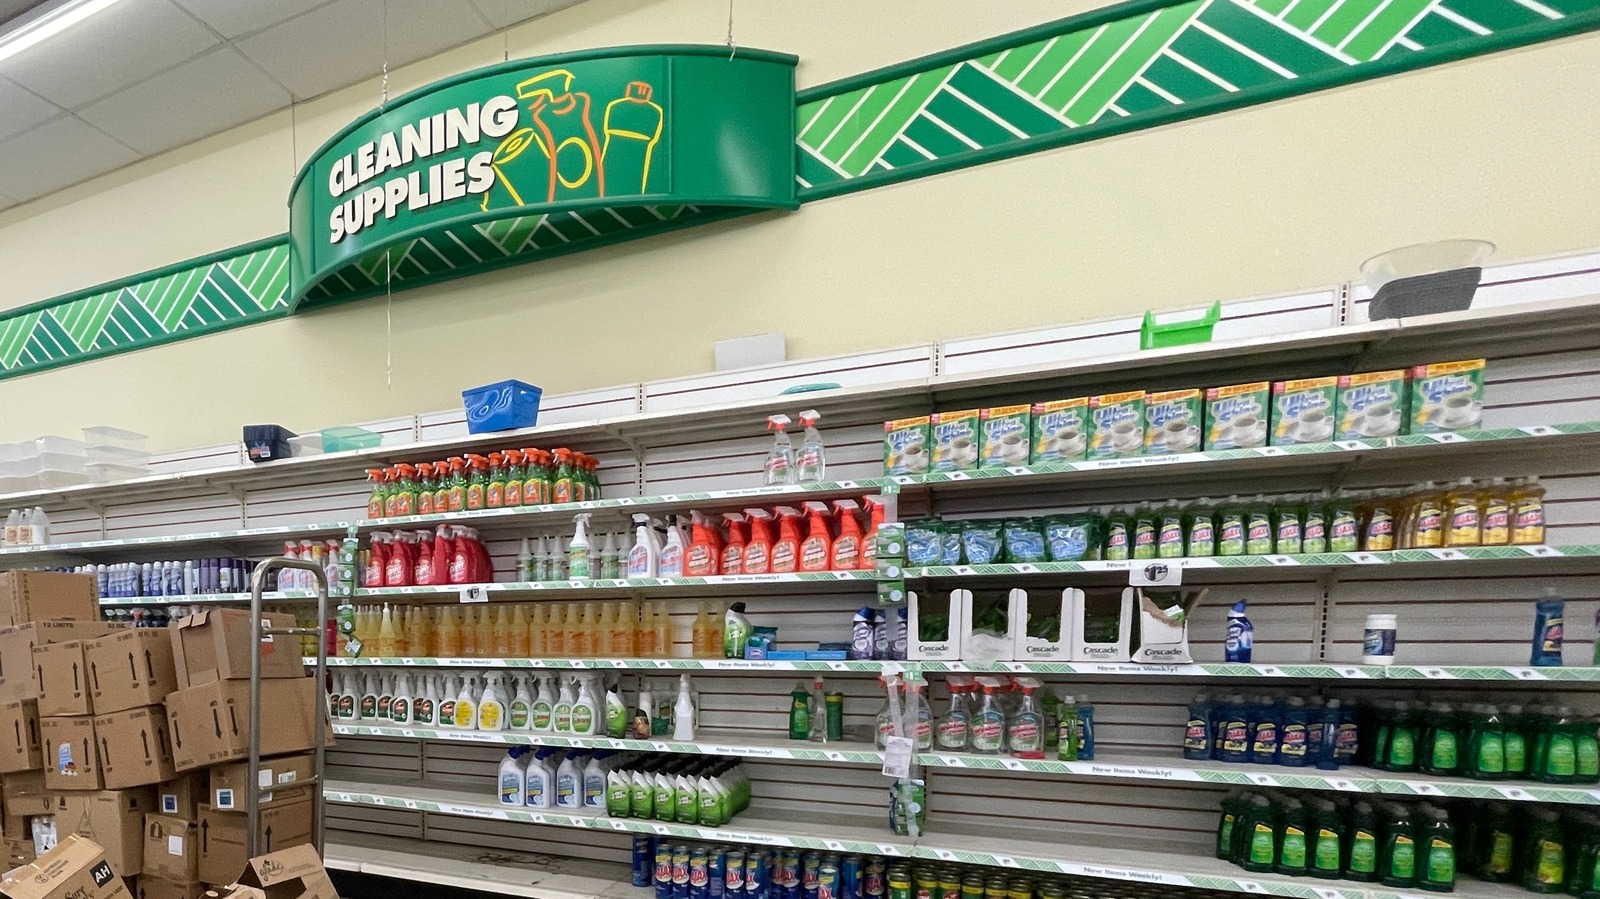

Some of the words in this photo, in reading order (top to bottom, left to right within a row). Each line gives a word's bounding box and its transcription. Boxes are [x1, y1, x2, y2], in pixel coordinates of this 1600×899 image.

[328, 96, 519, 198] CLEANING
[330, 152, 496, 244] SUPPLIES
[919, 644, 949, 652] Cascade
[1026, 645, 1060, 653] Cascade
[95, 865, 110, 884] AH
[260, 860, 281, 882] glade
